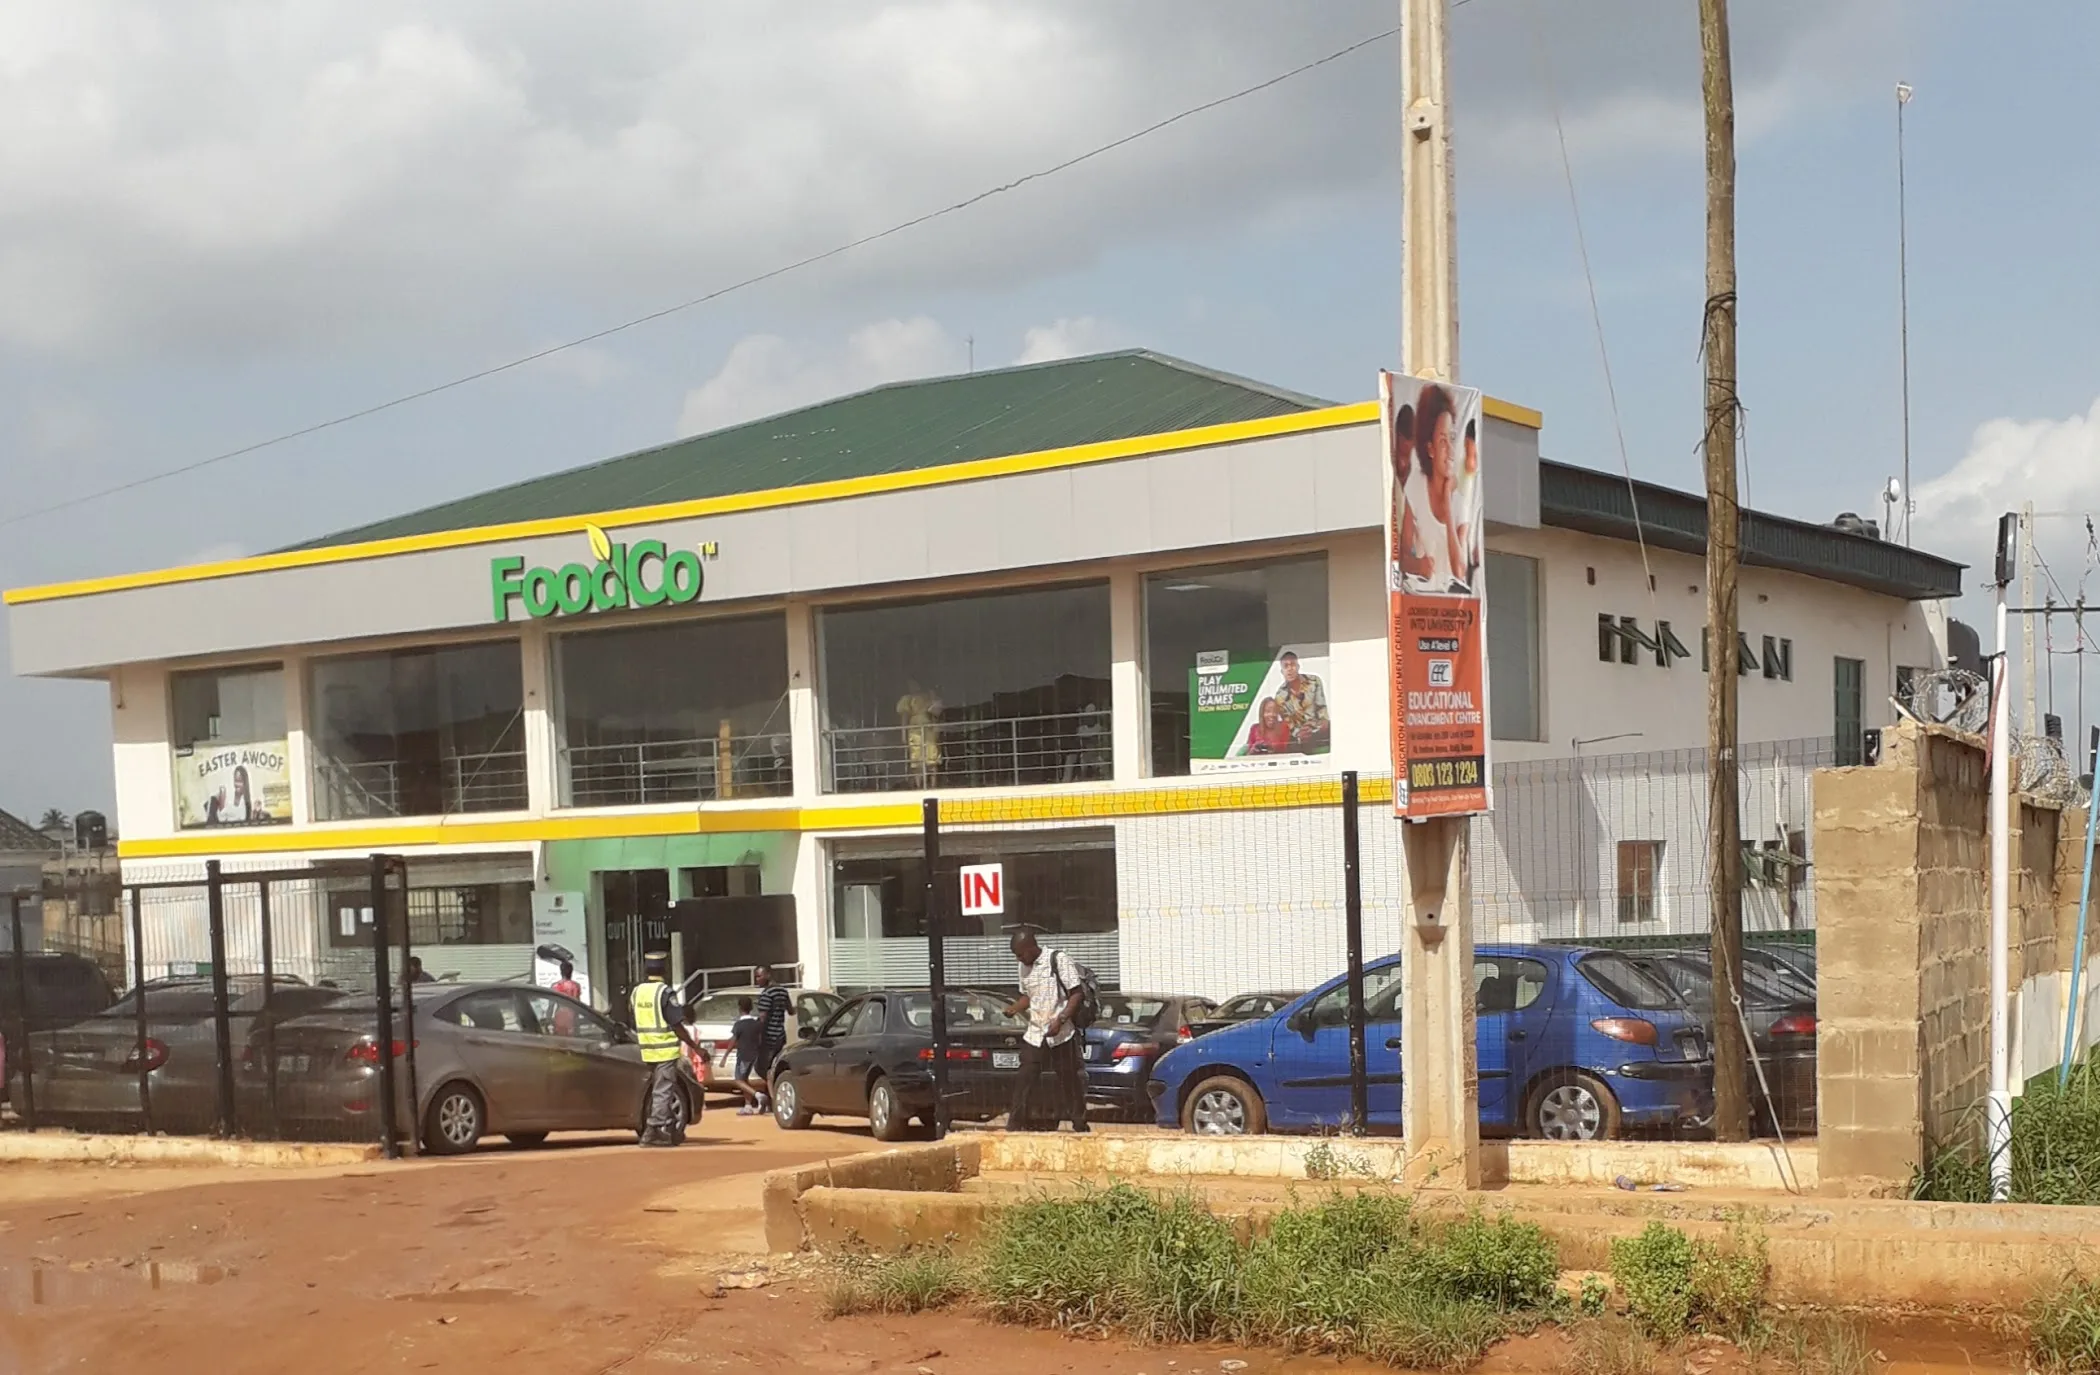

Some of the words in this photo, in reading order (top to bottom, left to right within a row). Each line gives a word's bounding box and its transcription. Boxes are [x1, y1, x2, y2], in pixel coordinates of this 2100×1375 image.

[491, 539, 704, 622] FoodCo
[1198, 675, 1222, 686] PLAY
[1198, 683, 1249, 696] UNLIMITED
[1198, 693, 1234, 706] GAMES
[1408, 691, 1474, 710] EDUCATIONAL
[1455, 710, 1482, 724] CENTRE
[198, 751, 238, 778] EASTER
[241, 749, 284, 772] AWOOF
[1436, 761, 1454, 786] 123
[1455, 760, 1478, 785] 1234
[963, 871, 1000, 909] IN
